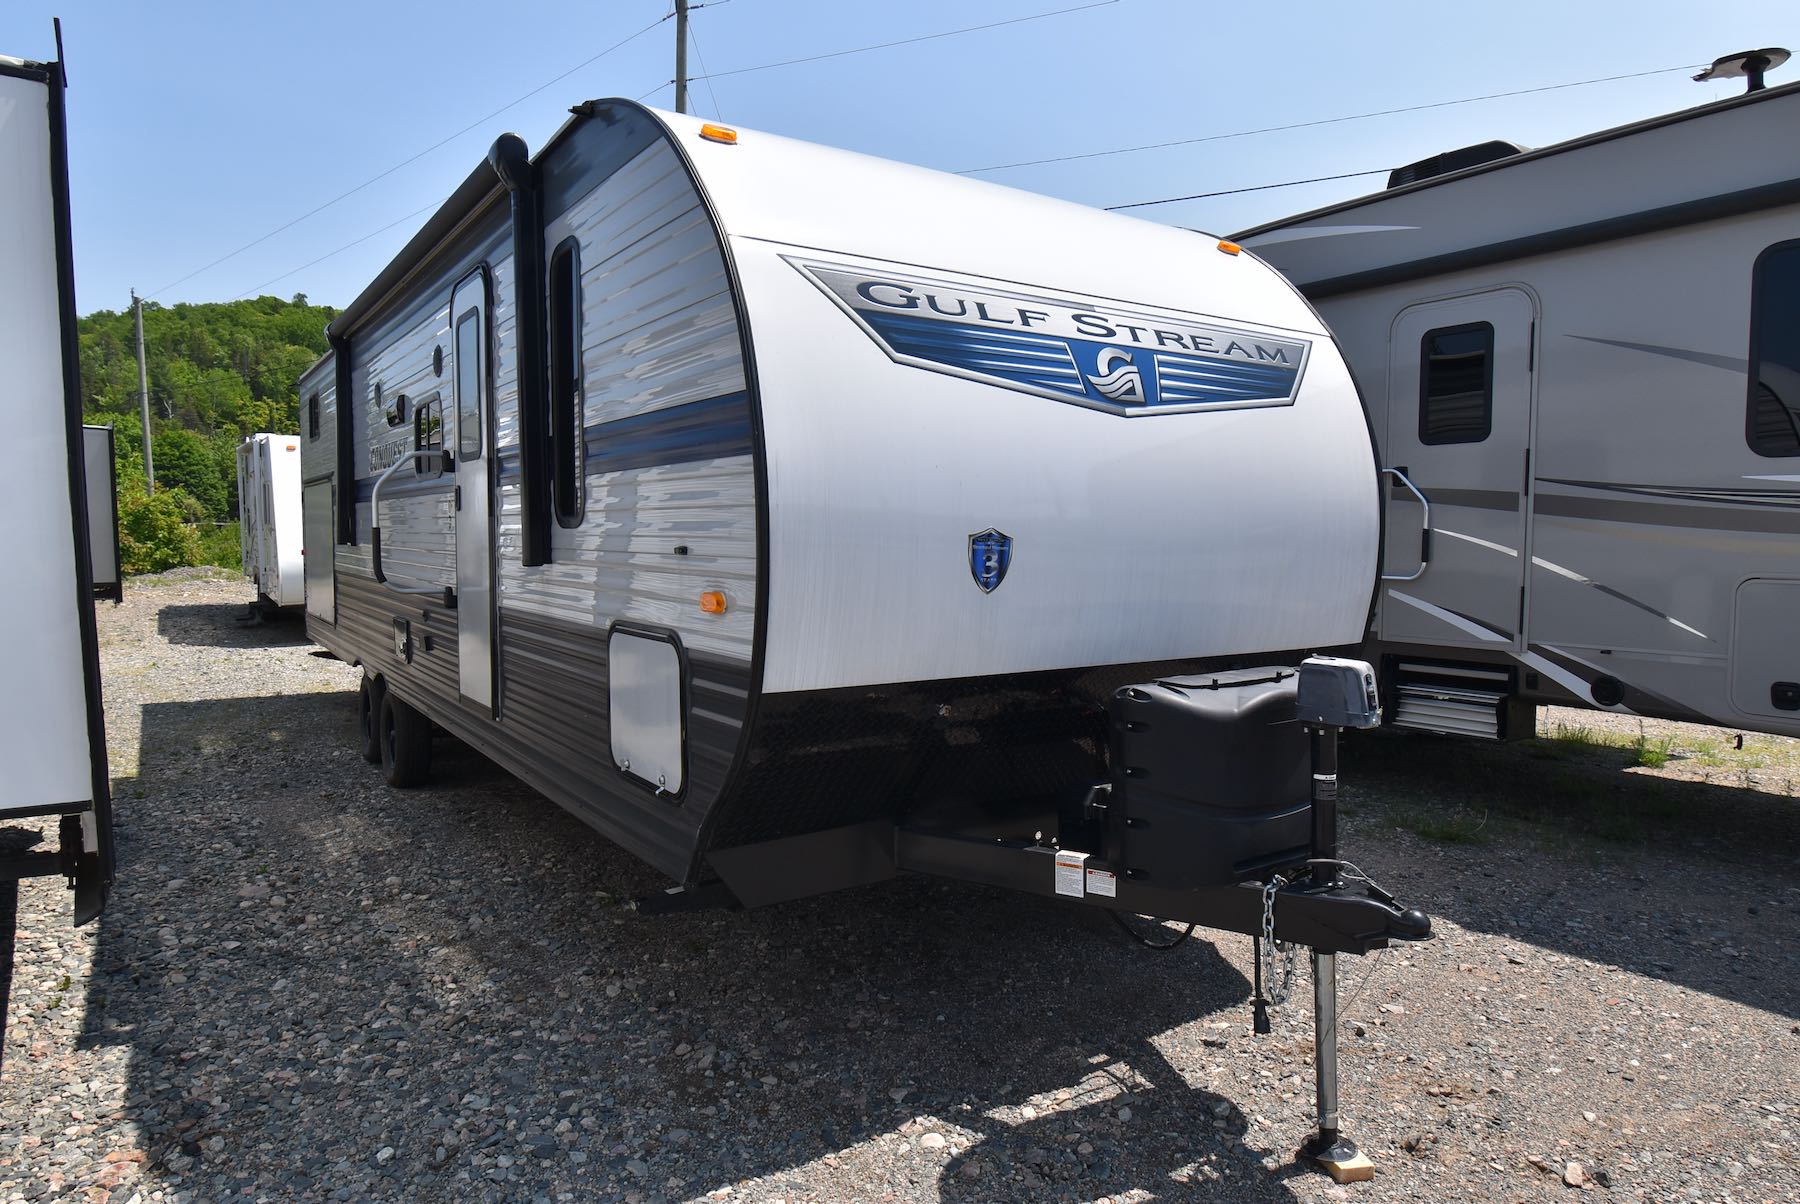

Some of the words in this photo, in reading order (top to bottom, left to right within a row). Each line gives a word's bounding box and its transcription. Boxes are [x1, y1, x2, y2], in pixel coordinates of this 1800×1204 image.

[856, 281, 1051, 328] GULF
[1071, 312, 1291, 365] STREAM
[982, 551, 999, 577] 3
